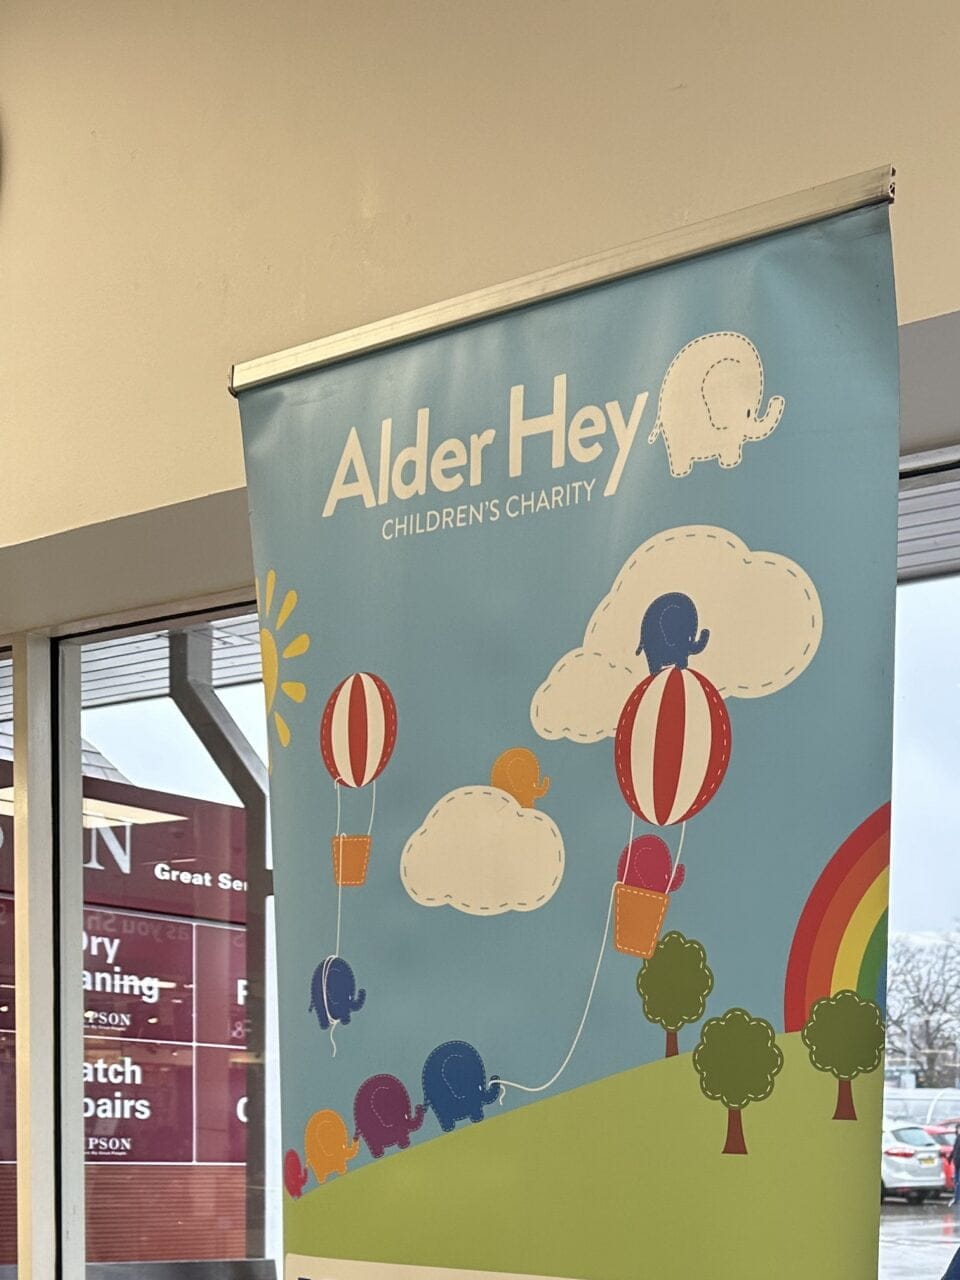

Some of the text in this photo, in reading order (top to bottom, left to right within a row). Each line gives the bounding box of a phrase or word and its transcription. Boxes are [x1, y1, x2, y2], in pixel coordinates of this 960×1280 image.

[322, 373, 649, 519] Alder Hey
[381, 478, 597, 542] CHILDREN'S CHARITY
[154, 863, 212, 887] Great
